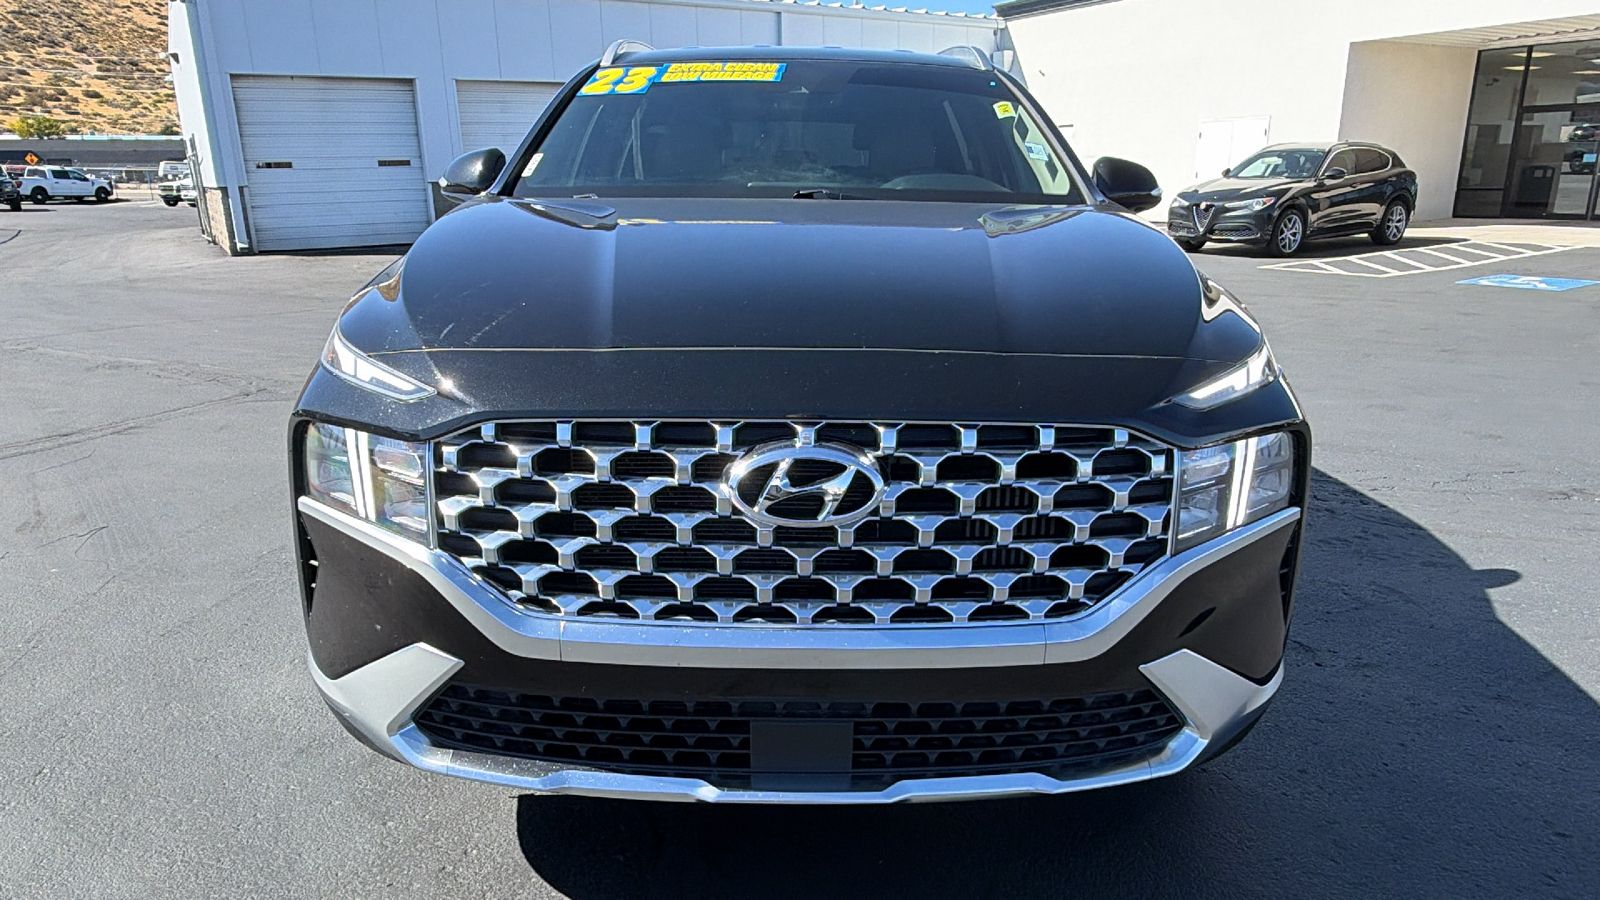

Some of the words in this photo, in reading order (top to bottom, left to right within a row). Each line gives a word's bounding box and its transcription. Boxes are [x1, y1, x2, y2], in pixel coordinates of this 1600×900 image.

[668, 63, 723, 72] EXTRA
[724, 63, 779, 72] CLEAN
[581, 67, 657, 94] 23
[661, 72, 700, 82] LOW
[700, 72, 776, 81] MILEAGE
